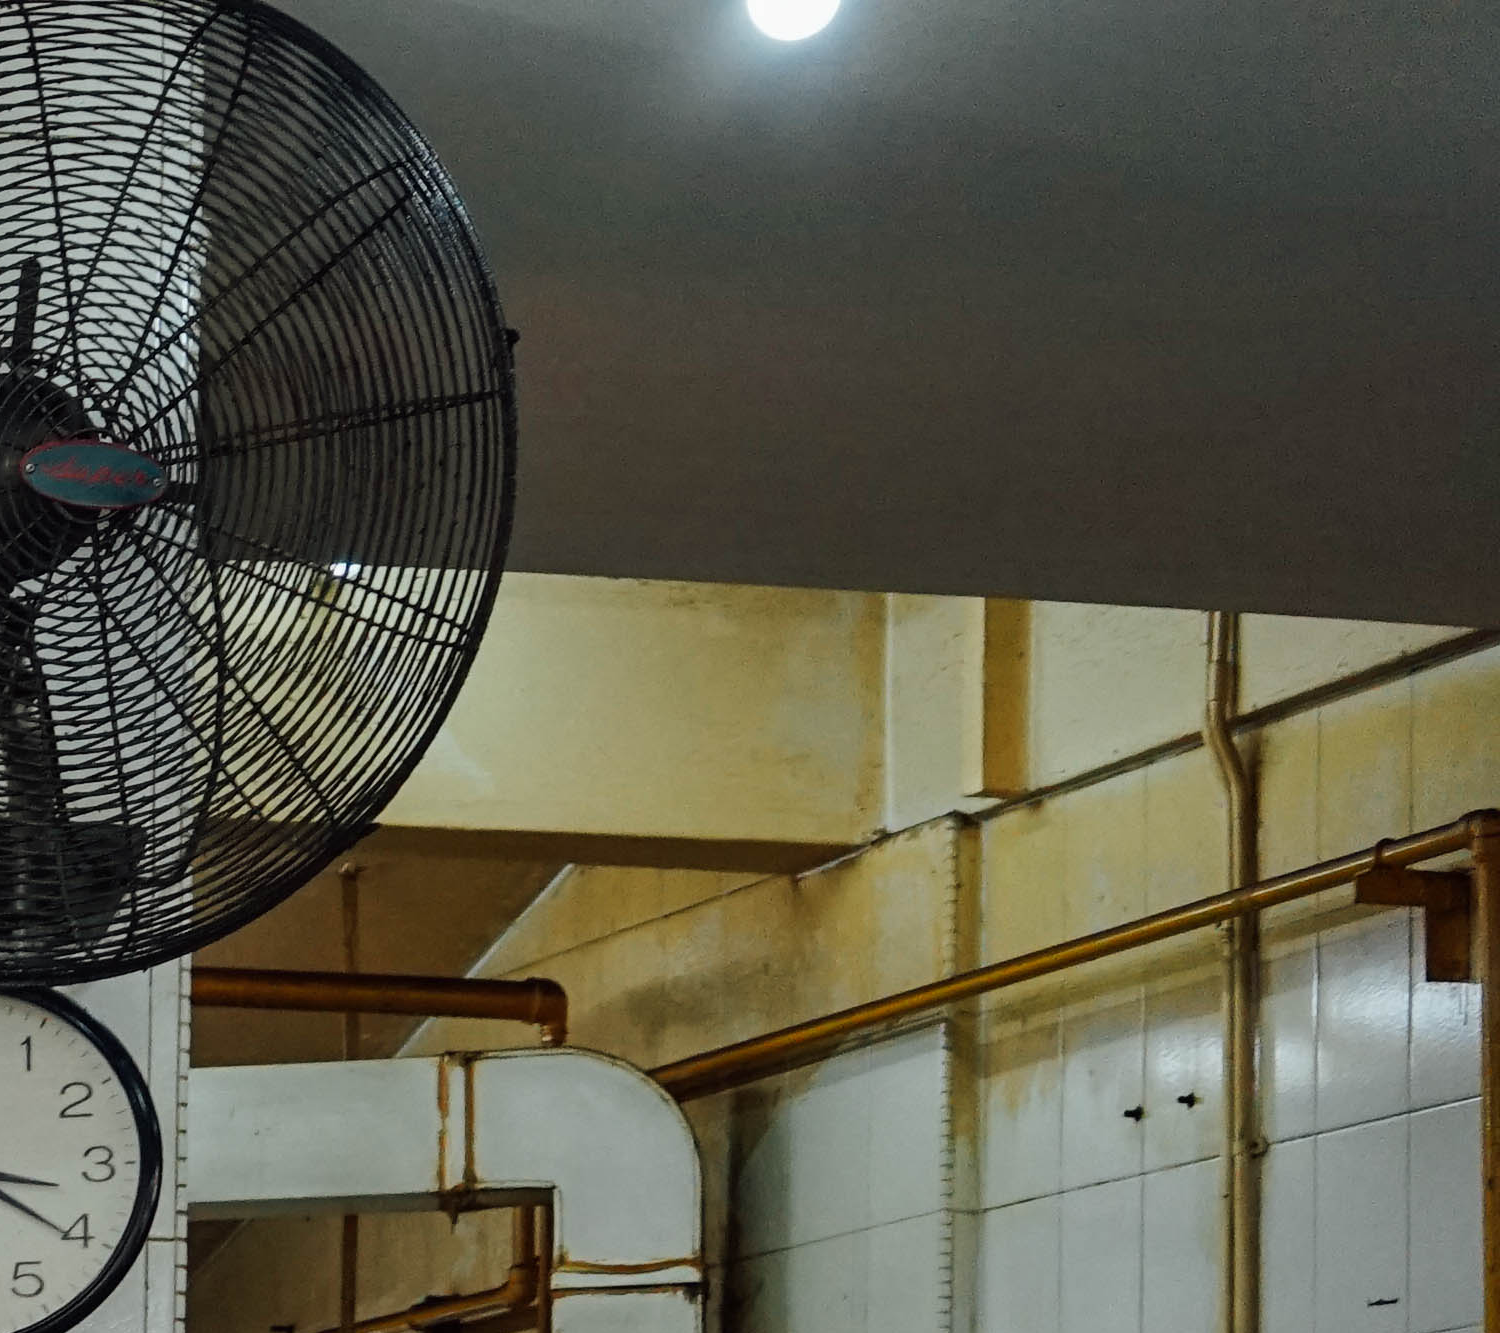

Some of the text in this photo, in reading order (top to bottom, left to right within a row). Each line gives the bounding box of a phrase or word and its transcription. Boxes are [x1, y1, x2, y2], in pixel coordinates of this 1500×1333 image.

[20, 1037, 32, 1071] 1
[59, 1081, 93, 1119] 2
[81, 1145, 115, 1183] 3
[61, 1213, 95, 1248] 4
[11, 1261, 45, 1298] 5
